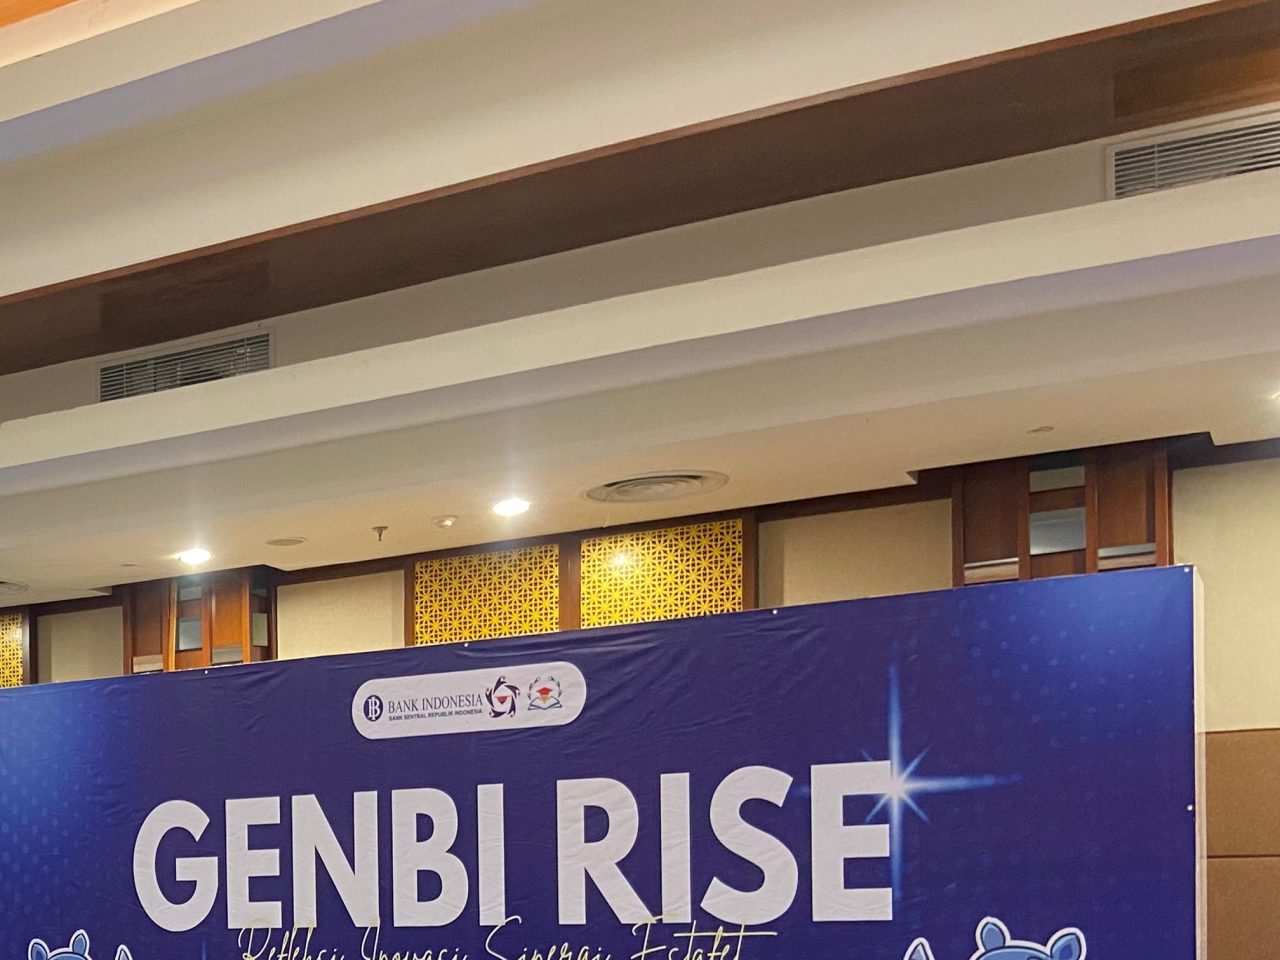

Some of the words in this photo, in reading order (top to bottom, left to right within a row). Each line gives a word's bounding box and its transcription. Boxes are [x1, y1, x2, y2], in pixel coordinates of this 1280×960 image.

[388, 698, 418, 714] BANK
[422, 694, 483, 711] INDONESIA
[454, 708, 483, 716] INDONESIA
[133, 784, 505, 932] GENBI
[556, 760, 894, 926] RISE
